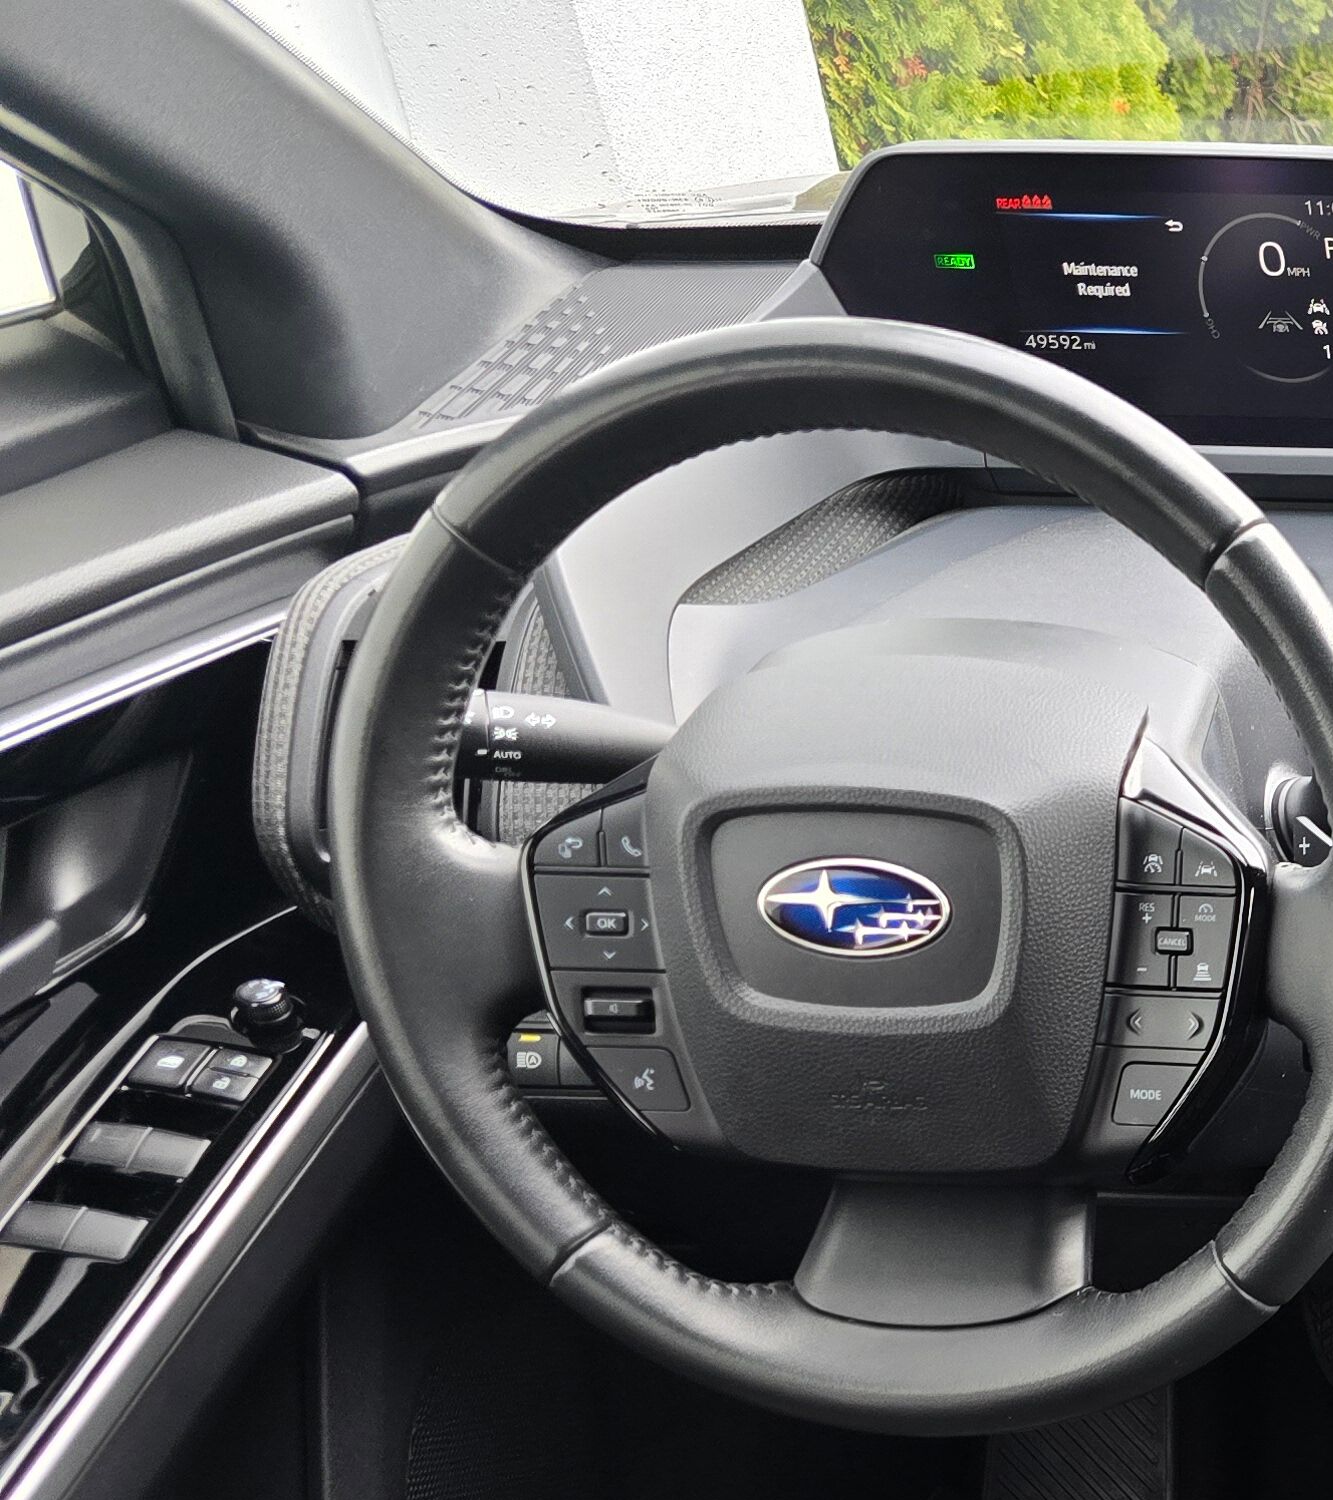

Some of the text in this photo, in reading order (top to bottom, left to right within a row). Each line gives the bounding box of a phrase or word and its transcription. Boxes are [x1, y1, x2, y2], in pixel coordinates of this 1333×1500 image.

[937, 256, 972, 267] READY
[1258, 241, 1311, 278] 0 MPH
[1062, 262, 1138, 278] Maintenance
[1077, 283, 1131, 298] Required
[1205, 319, 1220, 340] CHG
[1025, 334, 1096, 350] 49592 mi
[493, 750, 522, 760] AUTO
[1138, 902, 1155, 912] RES
[596, 917, 617, 930] OK
[1194, 914, 1216, 922] MODE
[1158, 937, 1187, 946] CANCEL
[1129, 1088, 1162, 1101] MODE
